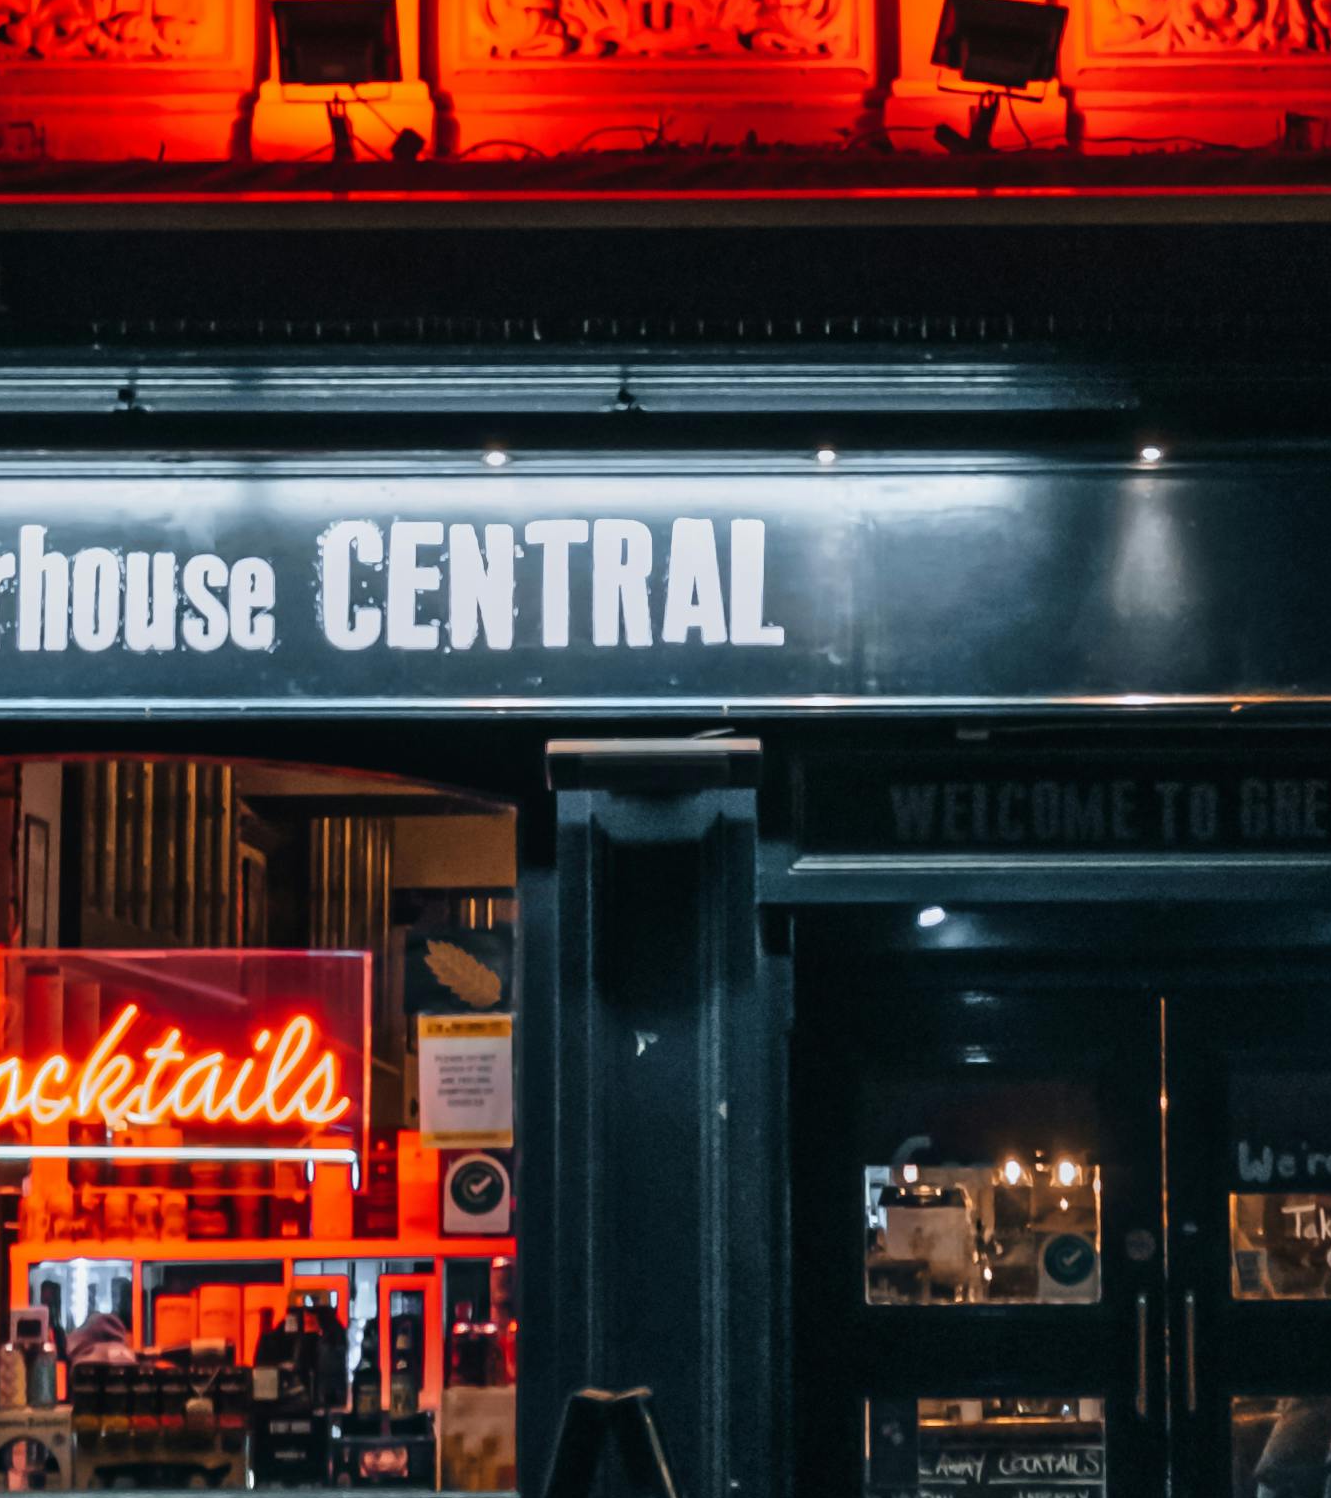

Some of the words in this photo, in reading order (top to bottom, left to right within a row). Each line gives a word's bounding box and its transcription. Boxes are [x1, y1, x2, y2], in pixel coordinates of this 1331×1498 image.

[319, 516, 785, 652] CENTRAL
[889, 779, 1138, 841] WELCOME
[1154, 779, 1220, 840] TO
[998, 1451, 1100, 1476] COCKTAILS
